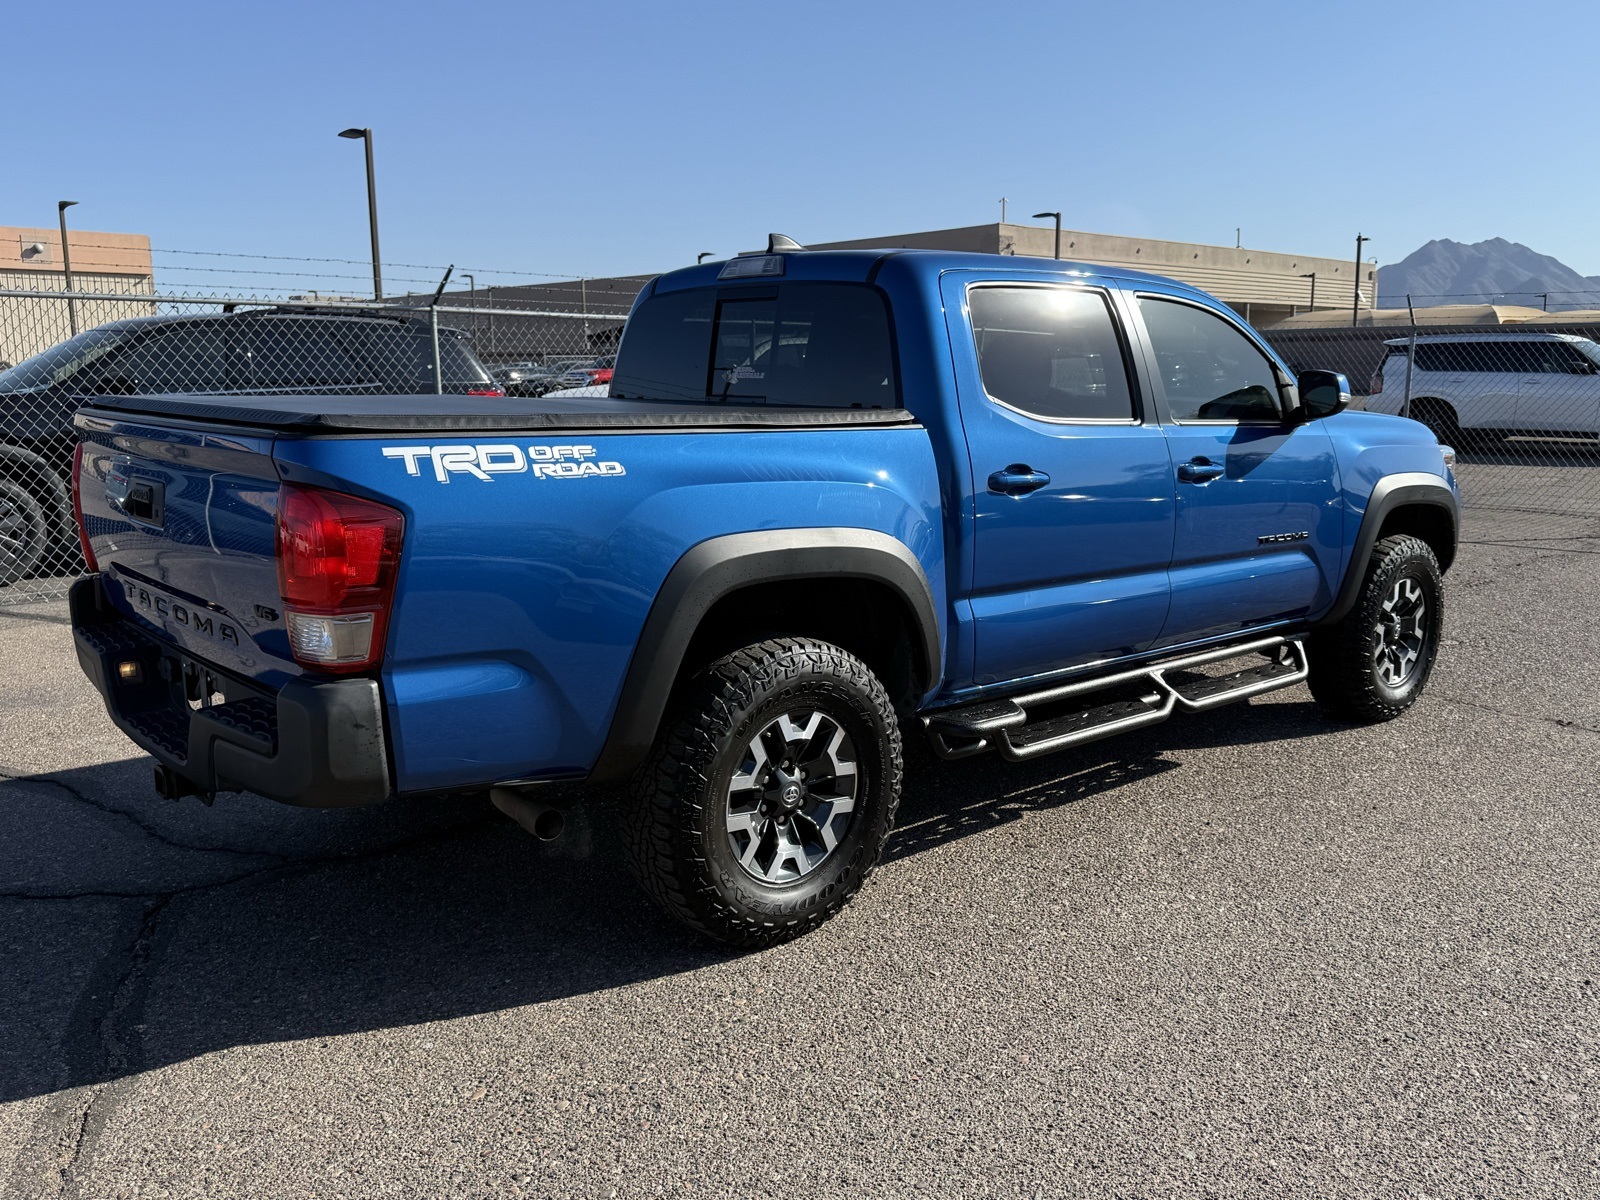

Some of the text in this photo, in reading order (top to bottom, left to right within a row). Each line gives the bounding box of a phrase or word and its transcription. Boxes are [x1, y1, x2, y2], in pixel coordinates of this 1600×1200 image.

[382, 445, 597, 484] TRD OFF
[532, 461, 627, 480] ROAD
[124, 580, 239, 646] TACOMA
[254, 604, 279, 621] V6
